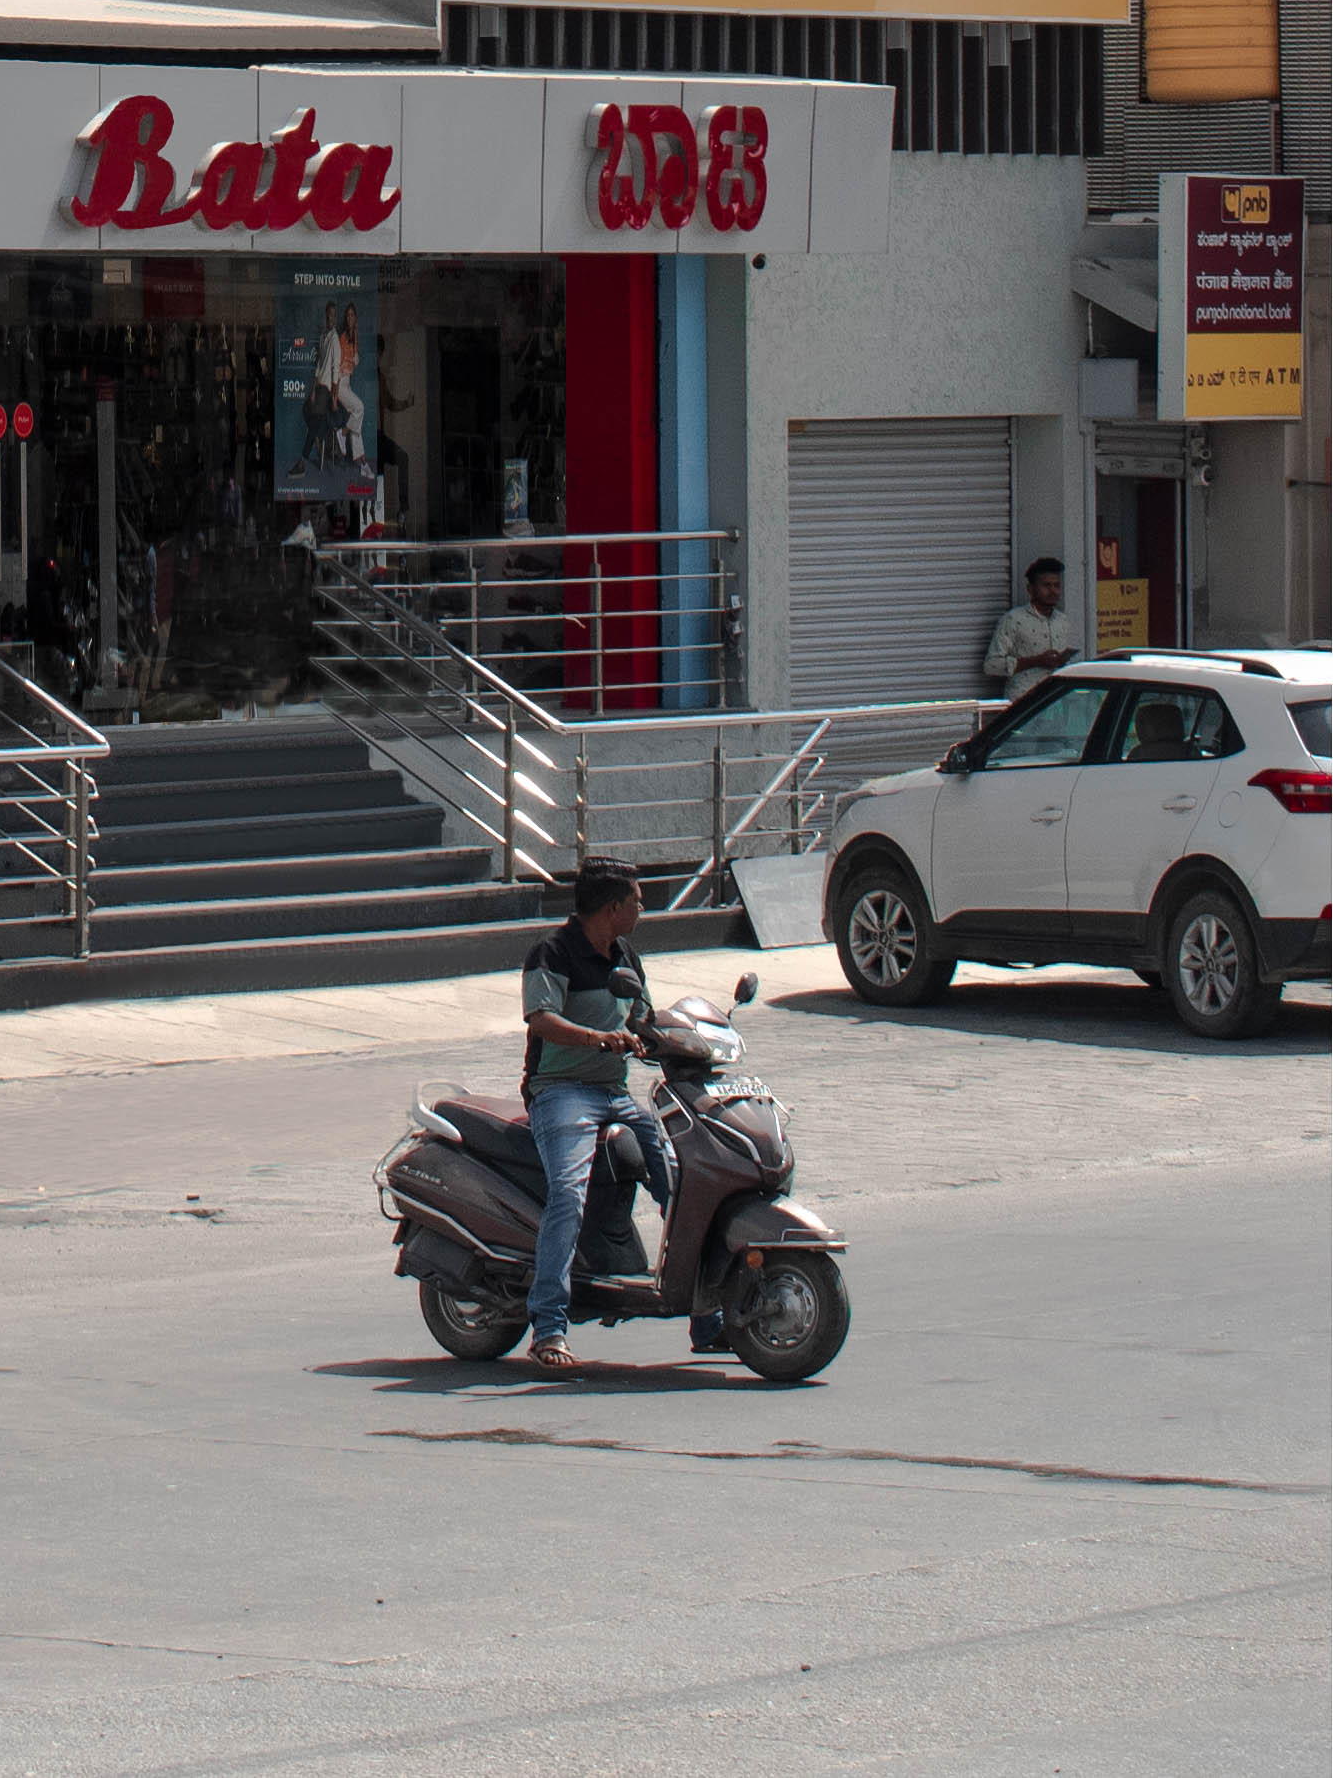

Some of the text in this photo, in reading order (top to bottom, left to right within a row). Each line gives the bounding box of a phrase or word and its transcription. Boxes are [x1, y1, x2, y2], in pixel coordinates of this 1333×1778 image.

[66, 94, 402, 232] Bata
[1242, 190, 1268, 218] pnb
[294, 272, 361, 287] STEP INTO STYLE
[1195, 271, 1229, 289] पंजाब
[1195, 302, 1293, 325] punjab national bank
[283, 379, 306, 392] 500+
